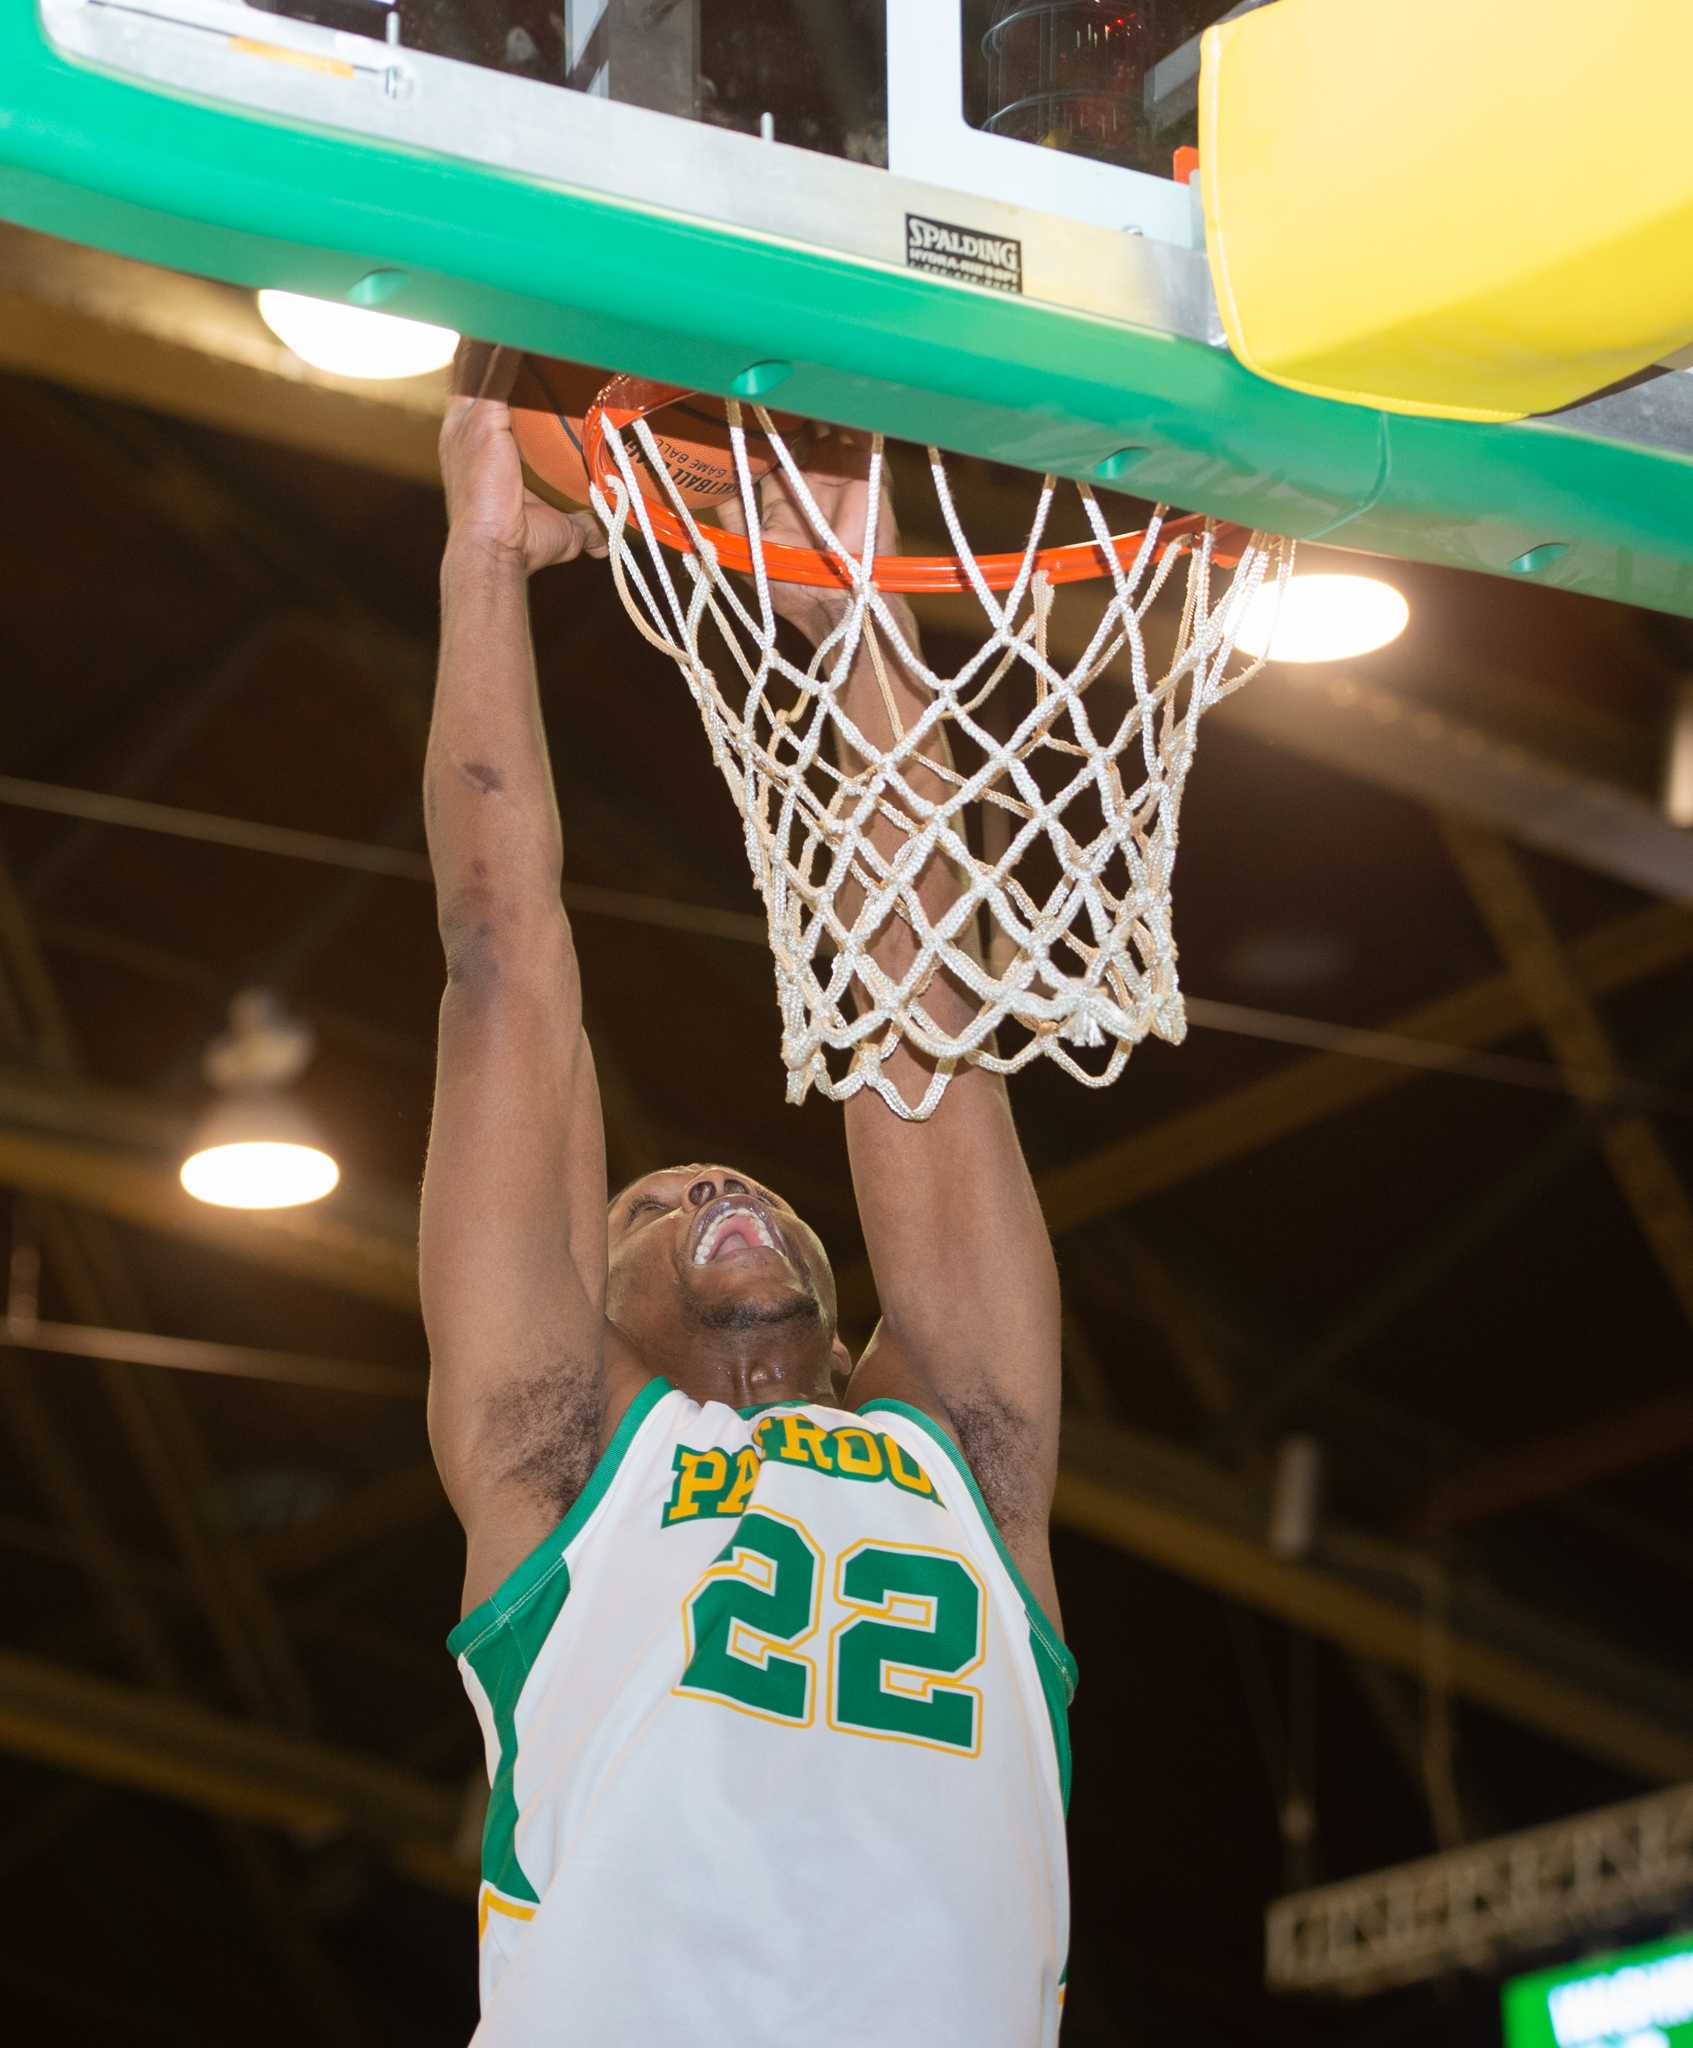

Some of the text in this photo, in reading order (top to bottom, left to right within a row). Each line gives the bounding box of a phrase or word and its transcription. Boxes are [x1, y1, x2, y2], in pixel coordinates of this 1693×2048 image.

[908, 217, 1018, 271] SPALDING
[655, 438, 689, 464] BALL
[689, 459, 727, 478] GAME
[669, 1504, 988, 1760] 22
